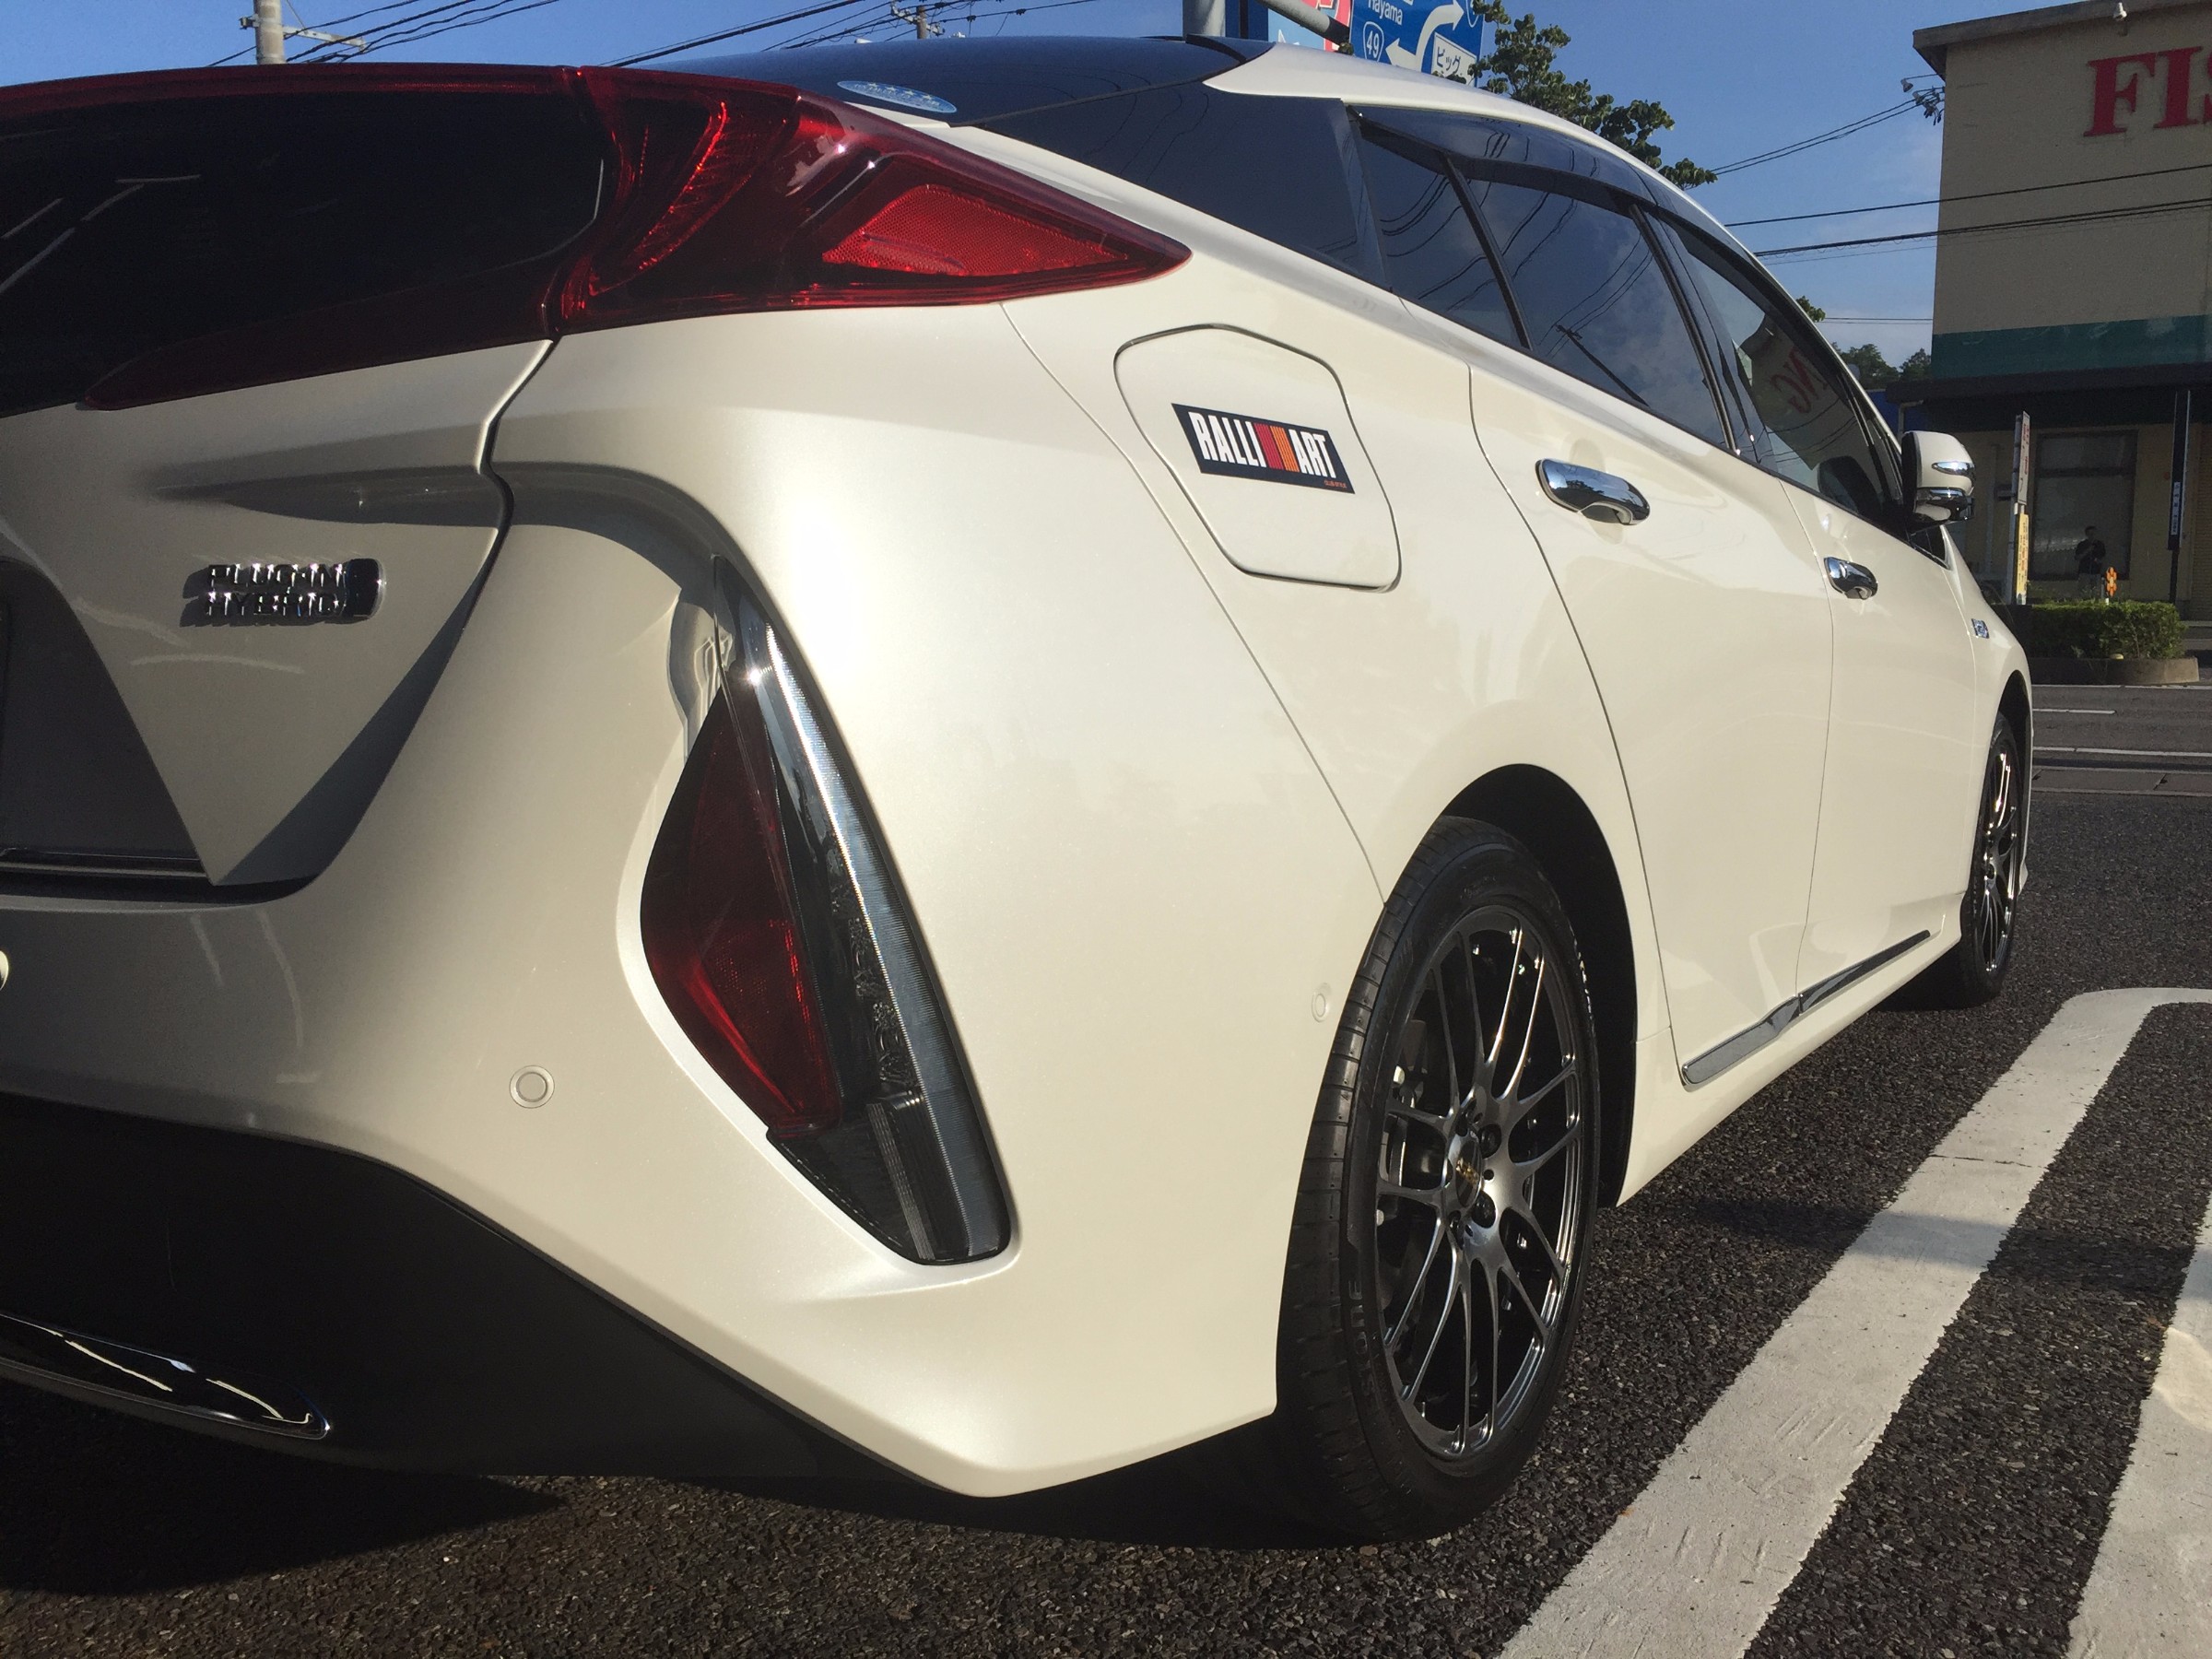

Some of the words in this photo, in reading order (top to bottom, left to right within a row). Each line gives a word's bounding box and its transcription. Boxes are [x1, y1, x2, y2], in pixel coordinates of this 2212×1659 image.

[1366, 29, 1380, 58] 49
[1436, 46, 1462, 75] ビッグ
[2083, 45, 2212, 137] FI
[1188, 411, 1267, 468] RALLI
[1288, 428, 1337, 479] ART
